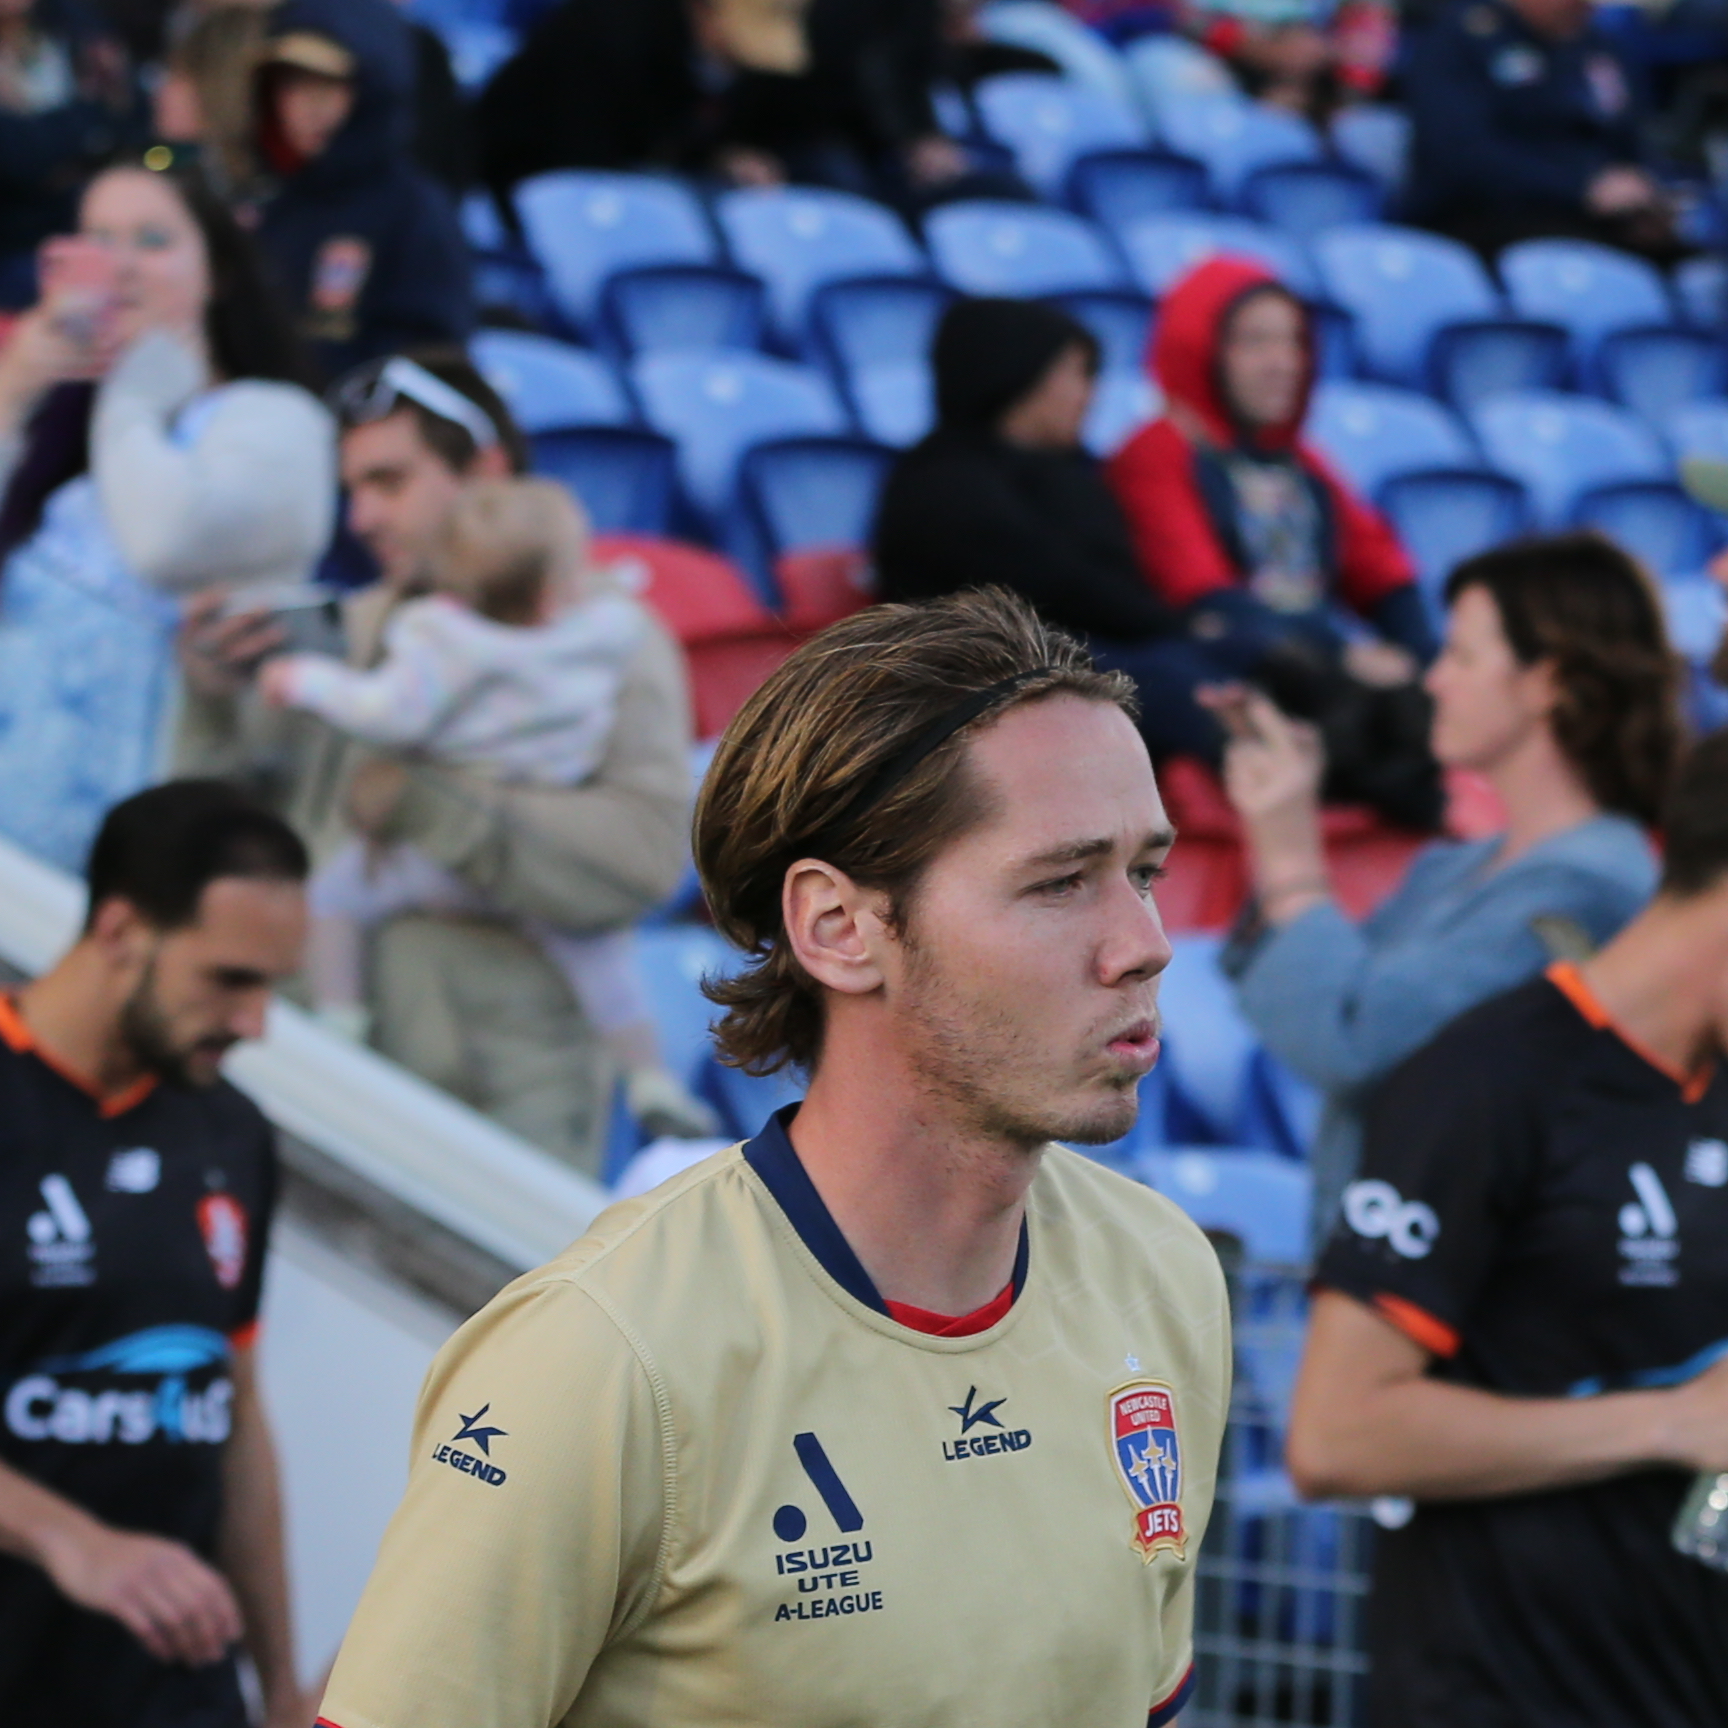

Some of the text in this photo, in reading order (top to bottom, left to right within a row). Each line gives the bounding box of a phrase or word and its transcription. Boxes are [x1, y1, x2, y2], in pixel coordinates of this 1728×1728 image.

[1119, 1396, 1168, 1416] NEWCASTLE
[1130, 1410, 1161, 1427] UNITED
[943, 1429, 1032, 1461] LEGEND
[432, 1443, 507, 1487] LEGEND
[1145, 1509, 1179, 1537] JETS
[775, 1541, 872, 1574] ISUZU
[798, 1570, 860, 1593] UTE
[774, 1591, 883, 1622] A-LEAGUE
